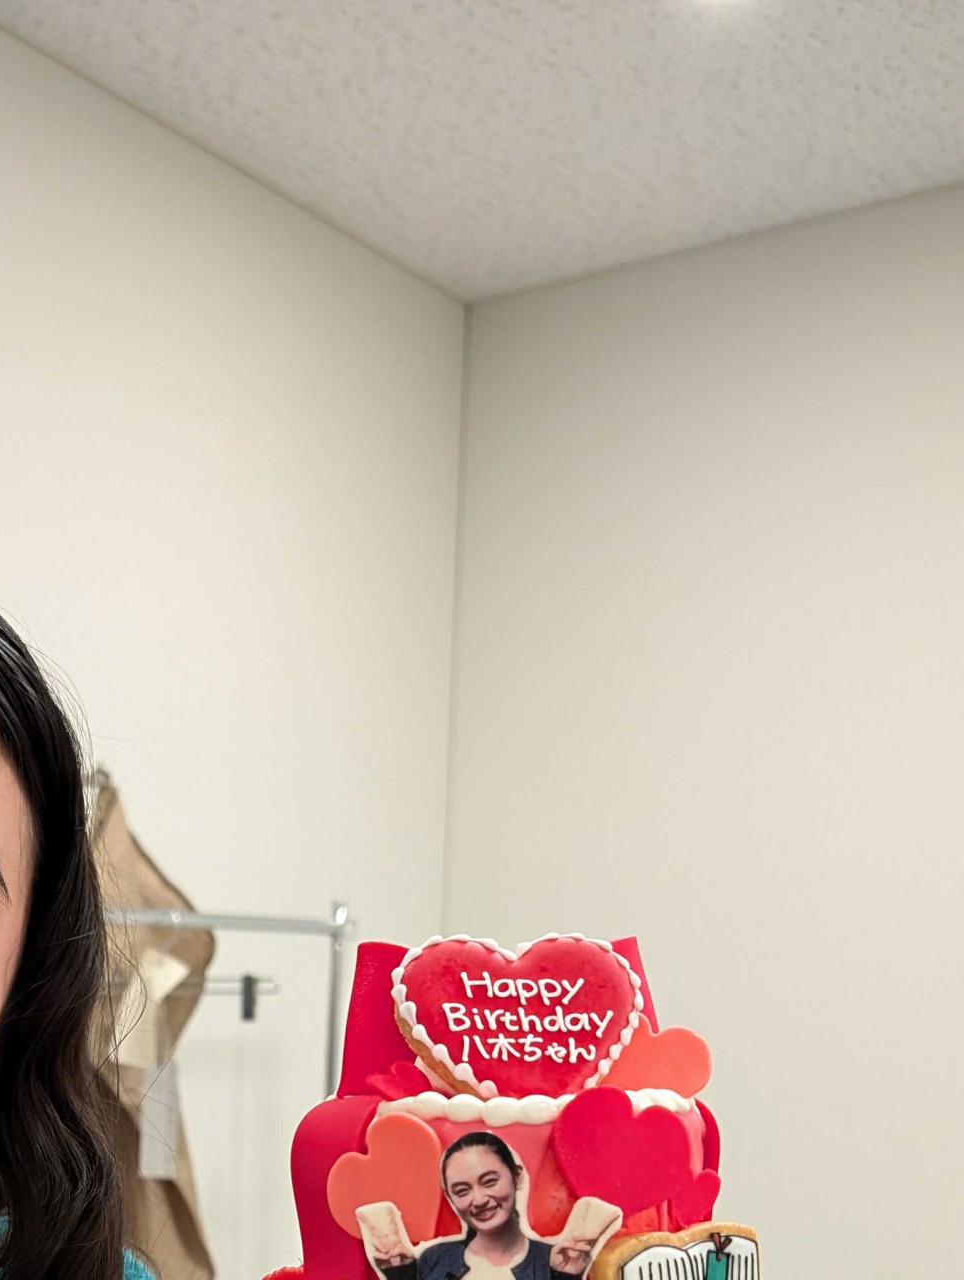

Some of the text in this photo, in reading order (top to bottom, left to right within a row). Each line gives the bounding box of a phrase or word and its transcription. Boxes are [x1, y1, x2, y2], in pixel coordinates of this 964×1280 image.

[460, 971, 585, 1005] Happy
[442, 1001, 614, 1038] Birthday
[461, 1033, 597, 1065] 八木ちゃん
